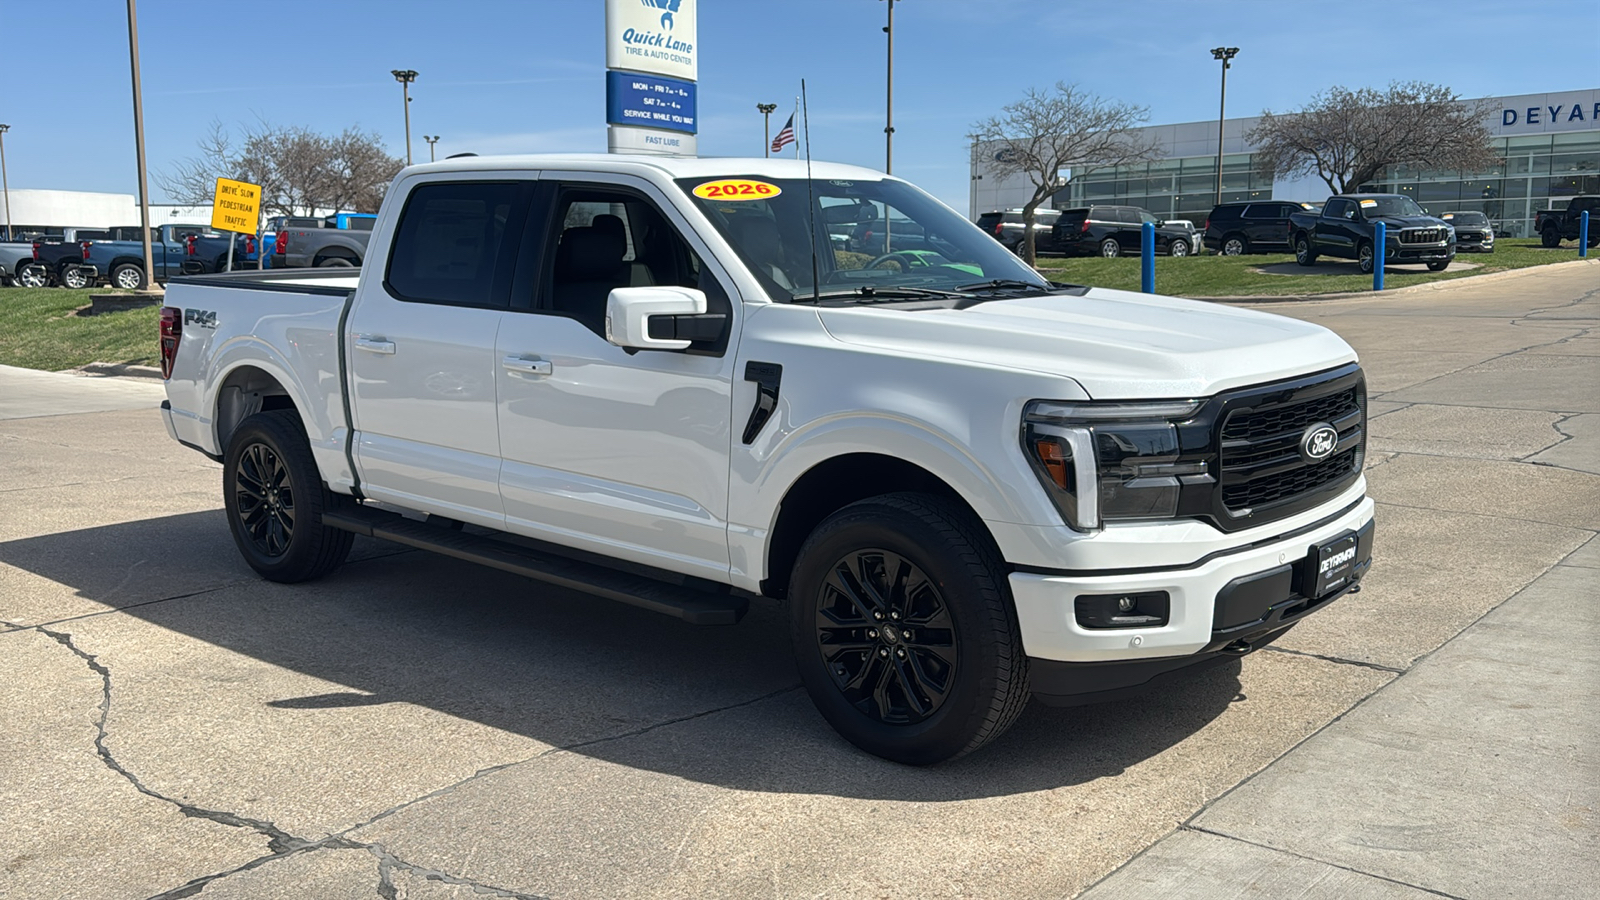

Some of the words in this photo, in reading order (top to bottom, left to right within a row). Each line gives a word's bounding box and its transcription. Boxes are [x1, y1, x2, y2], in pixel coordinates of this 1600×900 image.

[622, 28, 664, 47] Quick
[665, 35, 693, 54] Lane
[625, 46, 642, 56] TIRE
[644, 49, 649, 57] &
[650, 50, 669, 60] AUTO
[670, 53, 692, 65] CENTER
[632, 82, 648, 91] MON
[654, 84, 664, 93] FRI
[643, 97, 655, 106] SAT
[624, 109, 652, 118] SERVICE
[652, 112, 670, 121] WHILE
[646, 136, 662, 144] FAST
[664, 138, 680, 146] LUBE
[222, 185, 238, 196] DRIVE
[240, 188, 254, 198] SLOW
[706, 184, 771, 197] 2026
[220, 200, 253, 213] PEDESTRIAN
[224, 215, 246, 226] TRAFFIC
[184, 308, 216, 326] FX4
[1312, 432, 1332, 454] Ford
